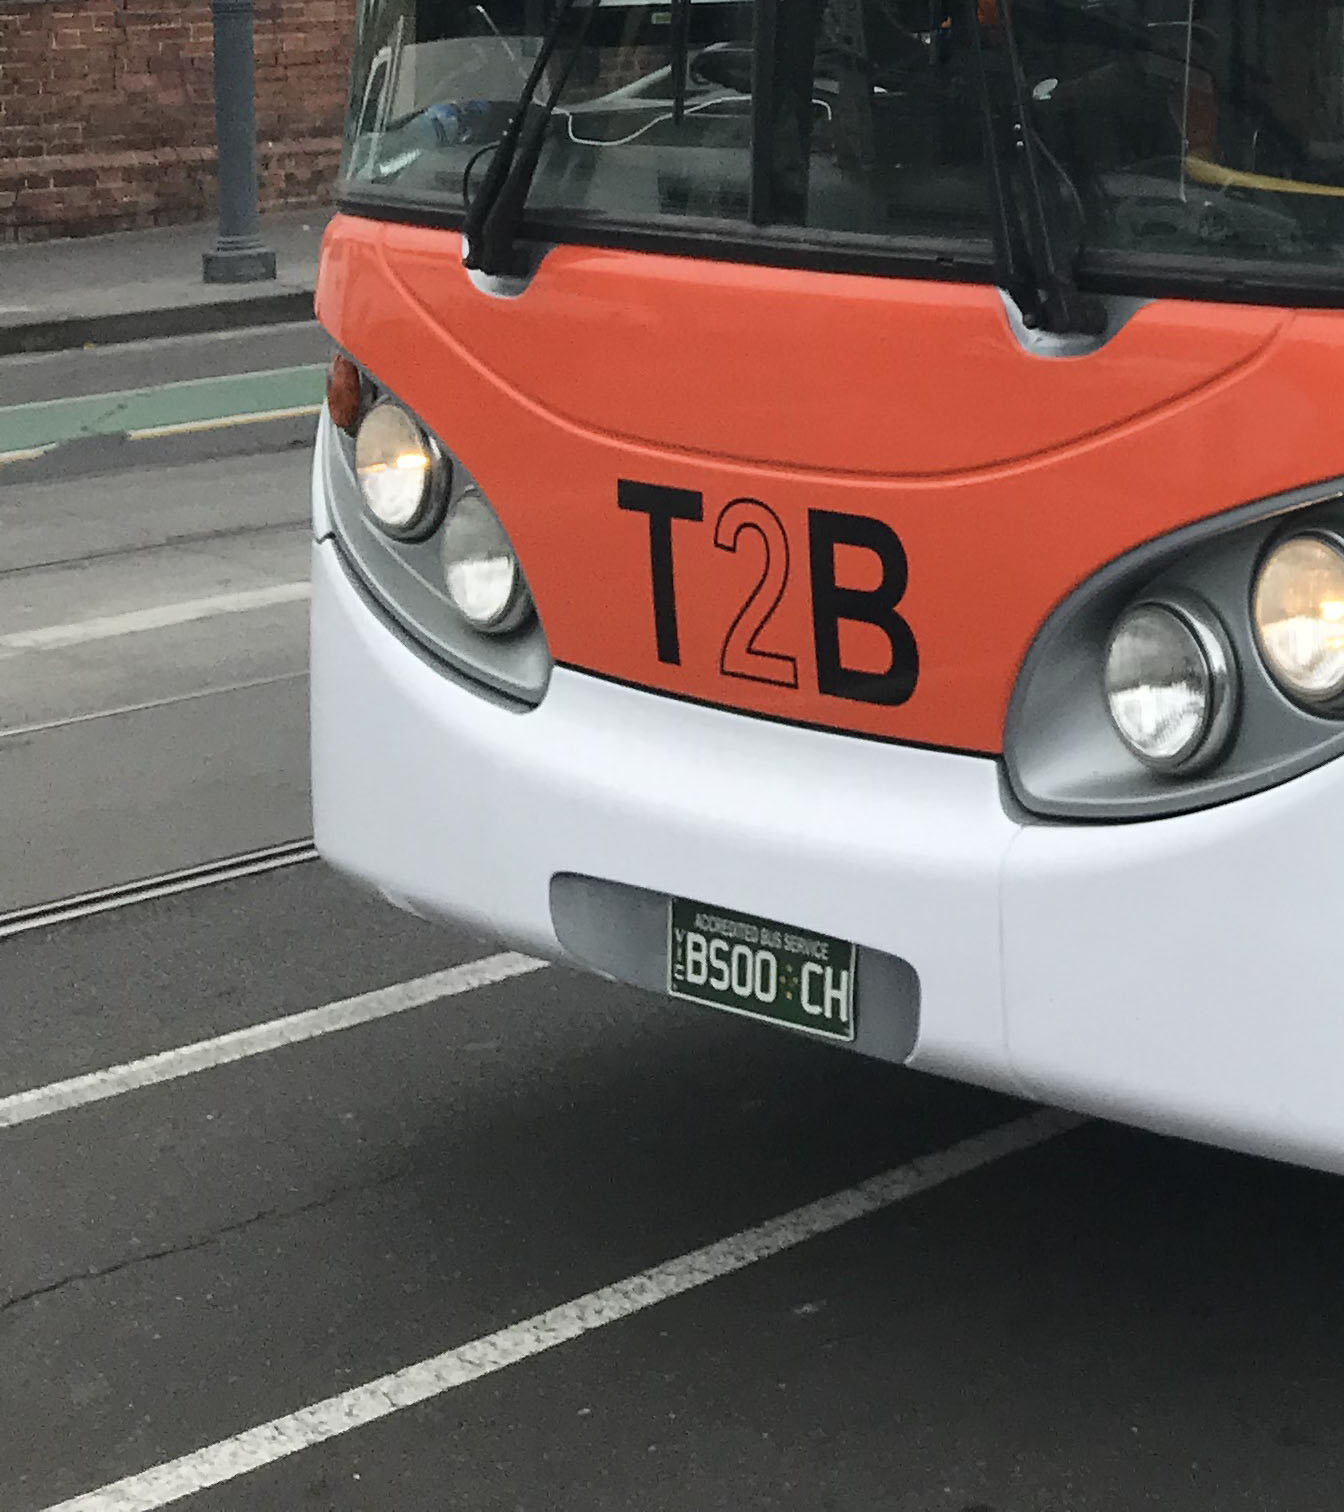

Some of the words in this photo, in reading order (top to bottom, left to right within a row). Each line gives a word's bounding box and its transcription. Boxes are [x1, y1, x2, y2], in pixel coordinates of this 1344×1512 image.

[617, 478, 920, 708] T2B
[760, 927, 782, 949] BUS
[801, 961, 849, 1023] CH
